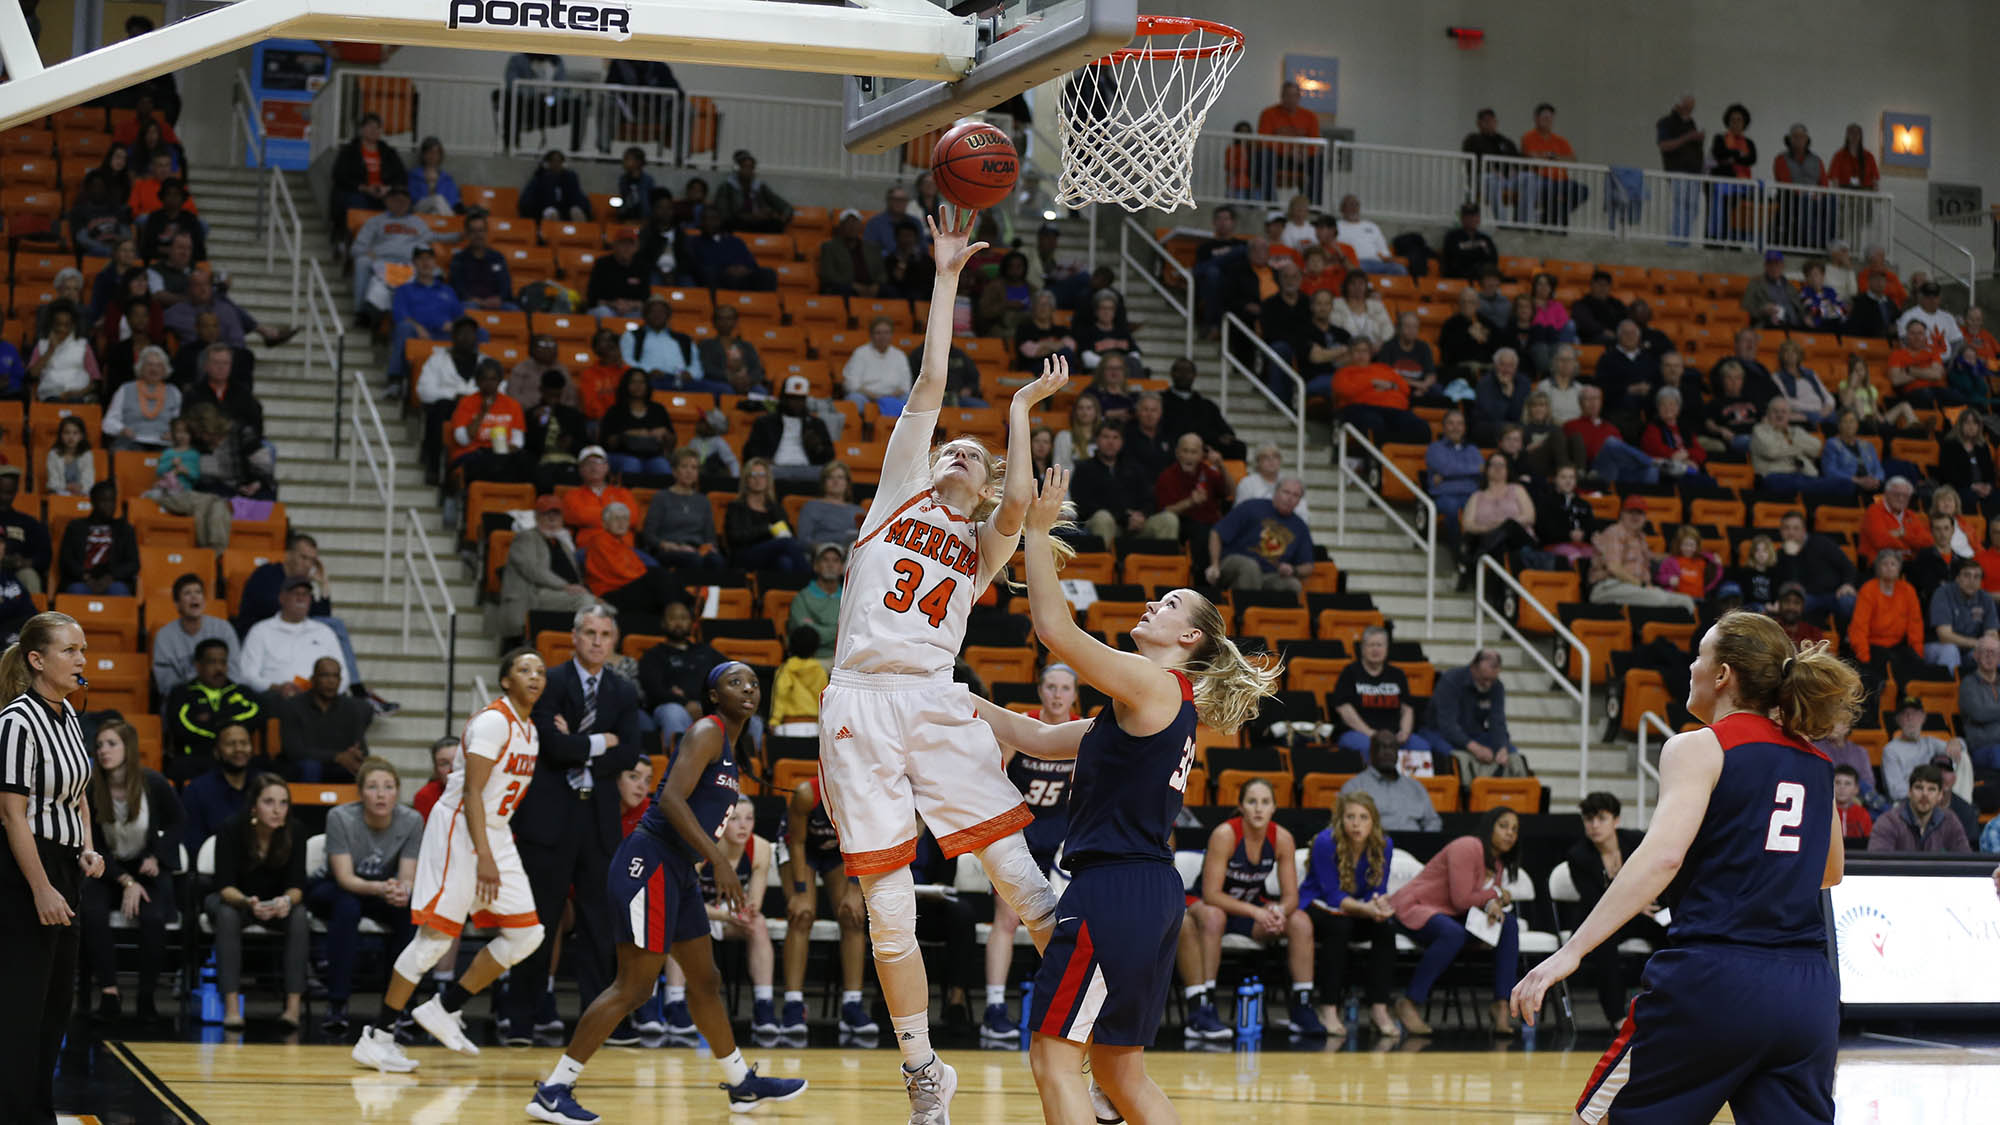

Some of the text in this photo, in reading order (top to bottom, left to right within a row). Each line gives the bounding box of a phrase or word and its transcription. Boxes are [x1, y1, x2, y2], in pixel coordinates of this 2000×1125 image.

[981, 159, 1015, 173] NCAA
[883, 557, 957, 628] 34
[1024, 779, 1065, 806] 35
[1764, 780, 1806, 853] 2
